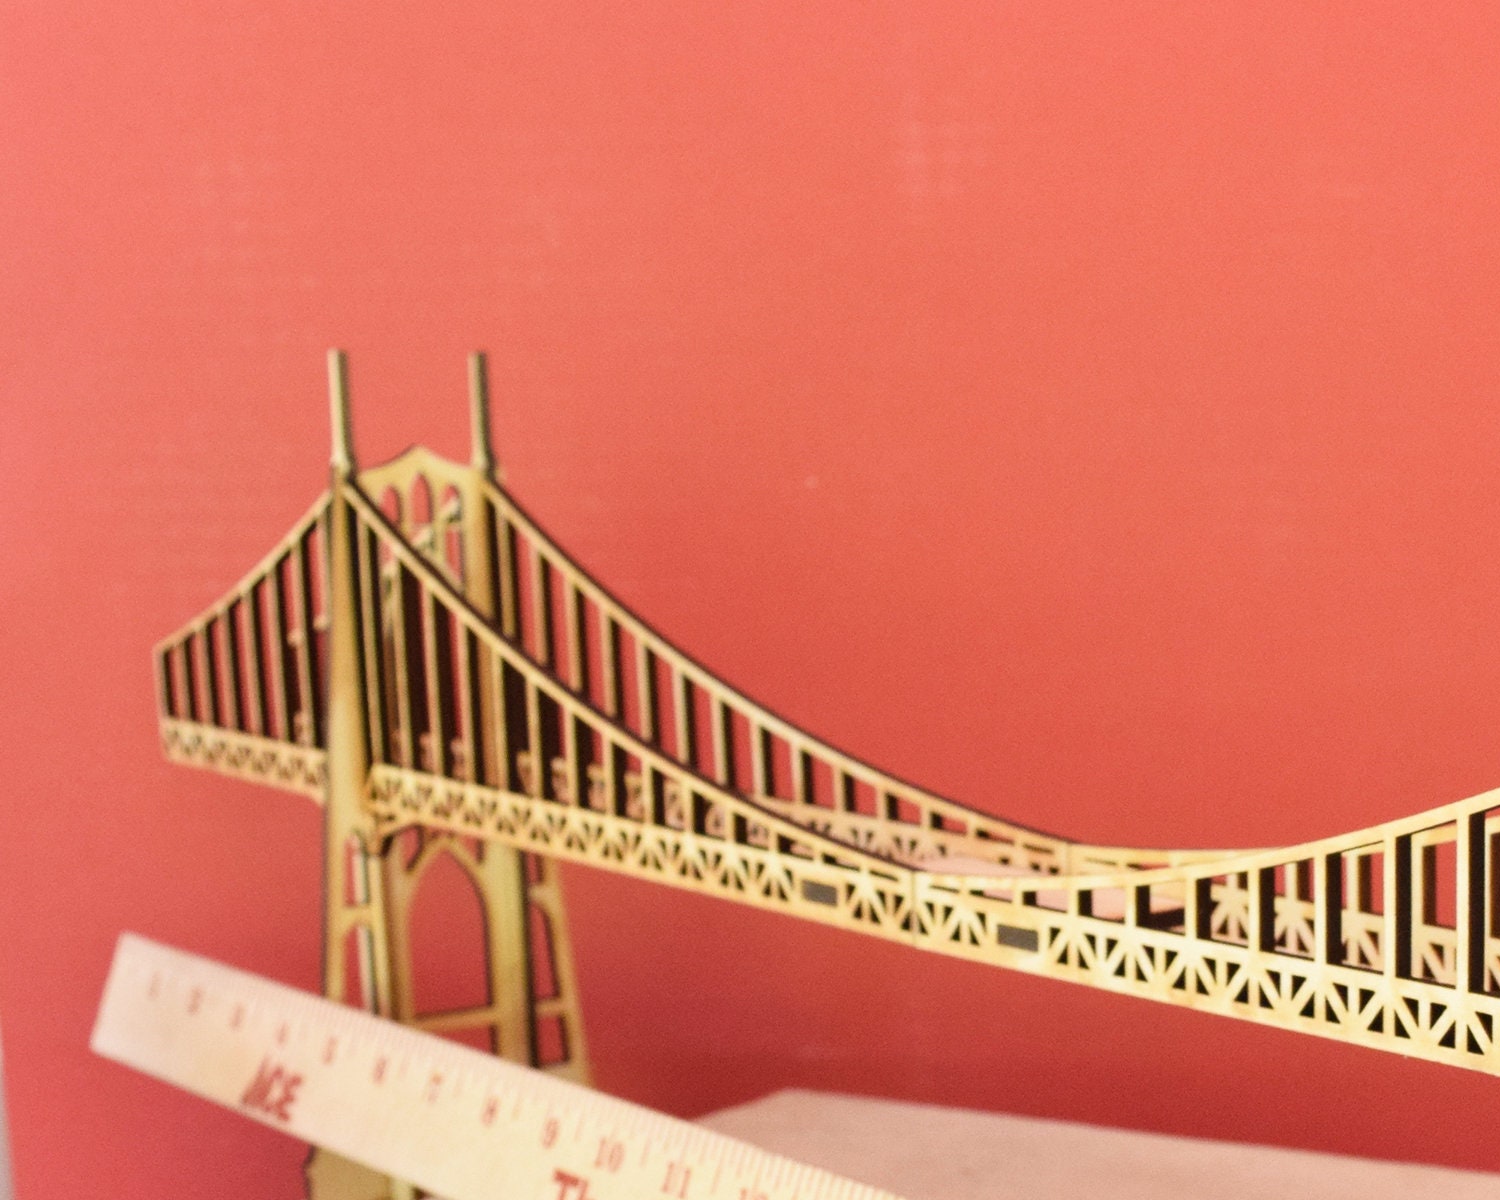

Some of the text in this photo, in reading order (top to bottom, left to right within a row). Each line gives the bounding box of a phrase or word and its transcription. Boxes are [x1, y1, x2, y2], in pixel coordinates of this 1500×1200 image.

[242, 1055, 304, 1122] ACE
[541, 1117, 560, 1149] 9
[595, 1136, 625, 1172] 10
[661, 1162, 692, 1200] 11
